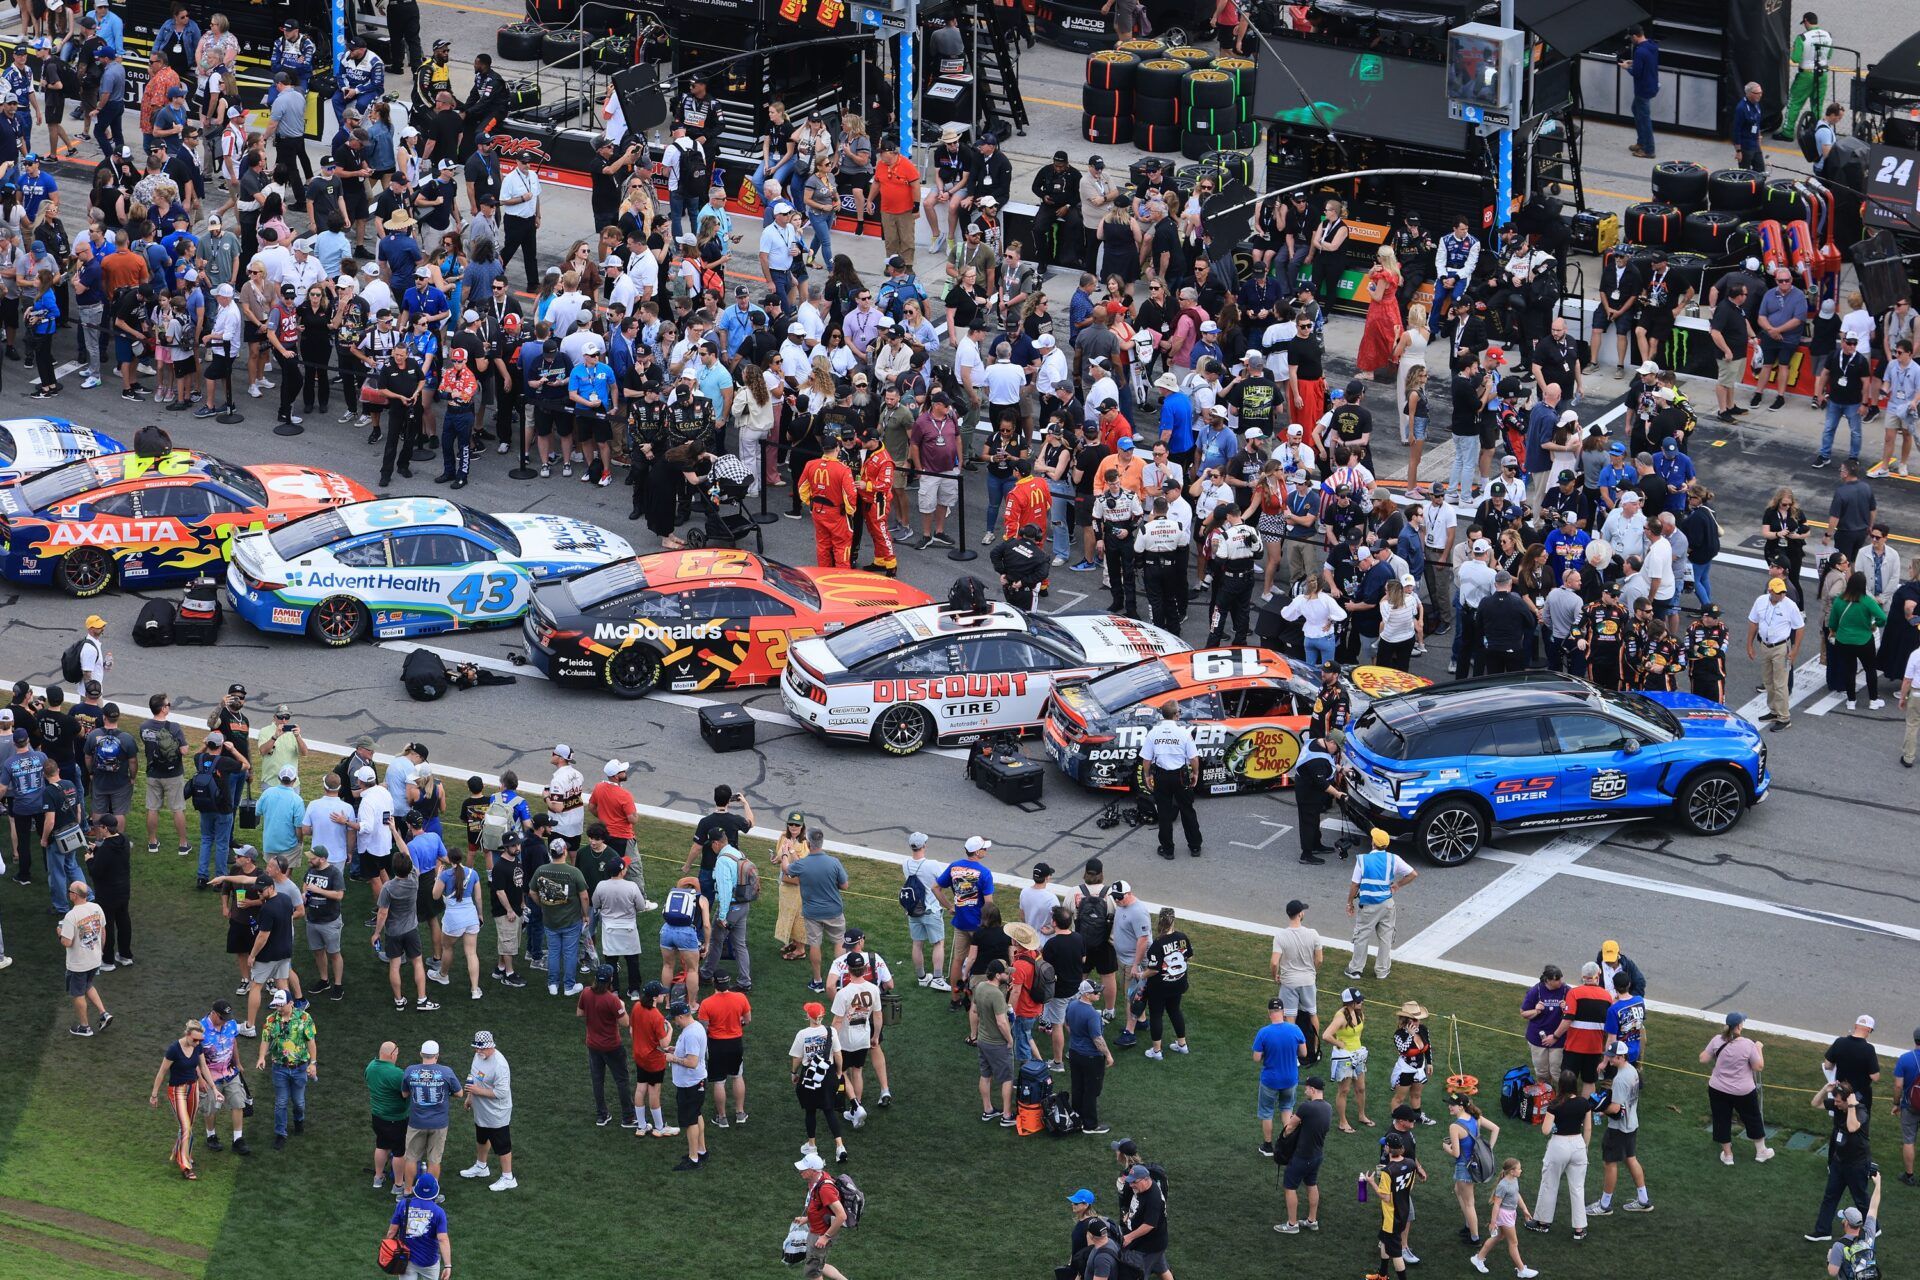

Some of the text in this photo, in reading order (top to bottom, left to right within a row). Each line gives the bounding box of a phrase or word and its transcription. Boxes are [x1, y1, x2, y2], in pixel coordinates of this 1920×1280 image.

[784, 2, 795, 13] 5
[821, 9, 833, 19] 5
[882, 18, 905, 27] musco
[1071, 17, 1105, 28] JACOB
[1070, 25, 1105, 33] CONSTRUCTION
[128, 71, 150, 79] GROU
[1484, 115, 1509, 125] musco
[1875, 156, 1914, 186] 24
[743, 191, 755, 205] 5
[51, 520, 179, 546] AXALTA
[447, 570, 518, 614] 43
[273, 608, 303, 618] FAMILY
[273, 615, 302, 624] DOLLAR
[593, 622, 722, 640] McDonald's
[569, 657, 593, 667] leidos
[565, 668, 596, 677] Columbia
[674, 682, 690, 690] Mobil
[873, 671, 1028, 703] DISCOUNT
[947, 702, 994, 715] TIRE
[809, 712, 817, 722] 2
[829, 717, 869, 725] MENARDS
[958, 735, 980, 743] FORD
[1254, 731, 1284, 746] Bass
[1071, 743, 1080, 753] 19
[1089, 748, 1138, 760] BOATS
[1255, 745, 1277, 758] Pro
[1254, 757, 1291, 773] Shops
[1592, 779, 1626, 793] 500
[1496, 791, 1548, 804] BLAZER
[1520, 818, 1561, 827] OFFICIAL
[1562, 815, 1586, 823] PACE
[1163, 941, 1178, 955] DALE
[1164, 951, 1187, 976] 8
[851, 991, 873, 1008] 40
[1632, 1006, 1645, 1019] 88
